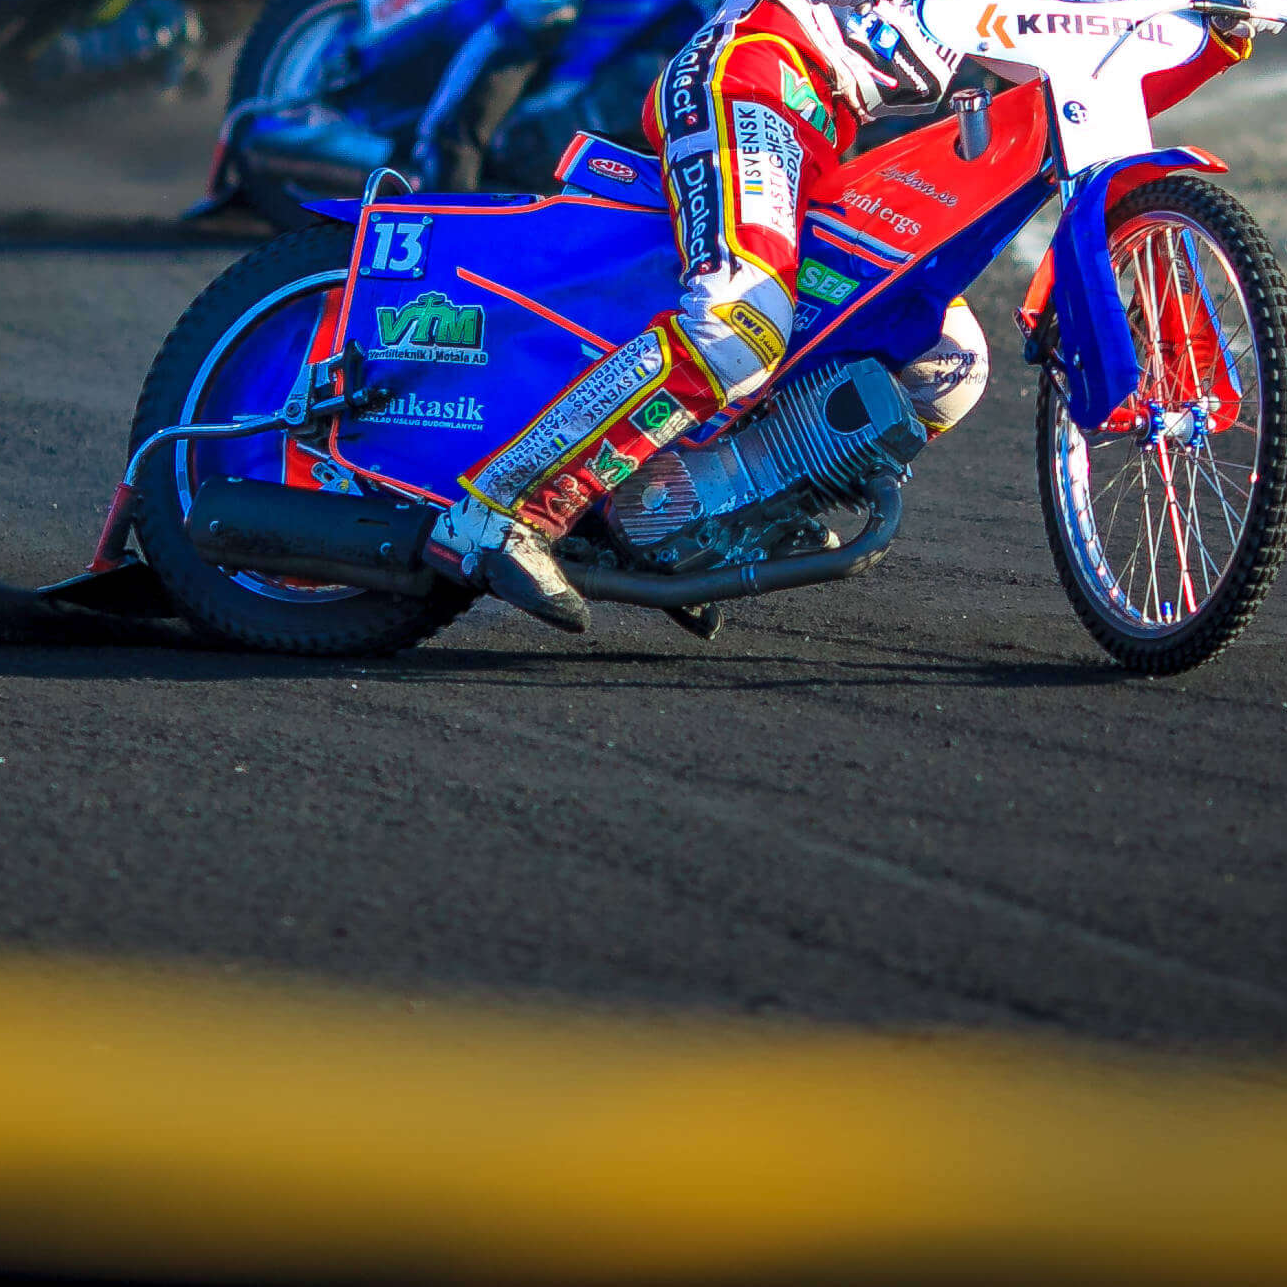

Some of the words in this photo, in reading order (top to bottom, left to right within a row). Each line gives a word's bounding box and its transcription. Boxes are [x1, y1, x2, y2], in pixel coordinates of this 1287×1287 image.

[673, 26, 715, 119] Dialect
[738, 107, 762, 178] SVENSK
[682, 159, 711, 263] Dialect
[371, 222, 426, 272] 13
[801, 265, 855, 299] SEB
[377, 297, 485, 349] VTM
[434, 351, 471, 364] Motala
[471, 353, 488, 364] AB
